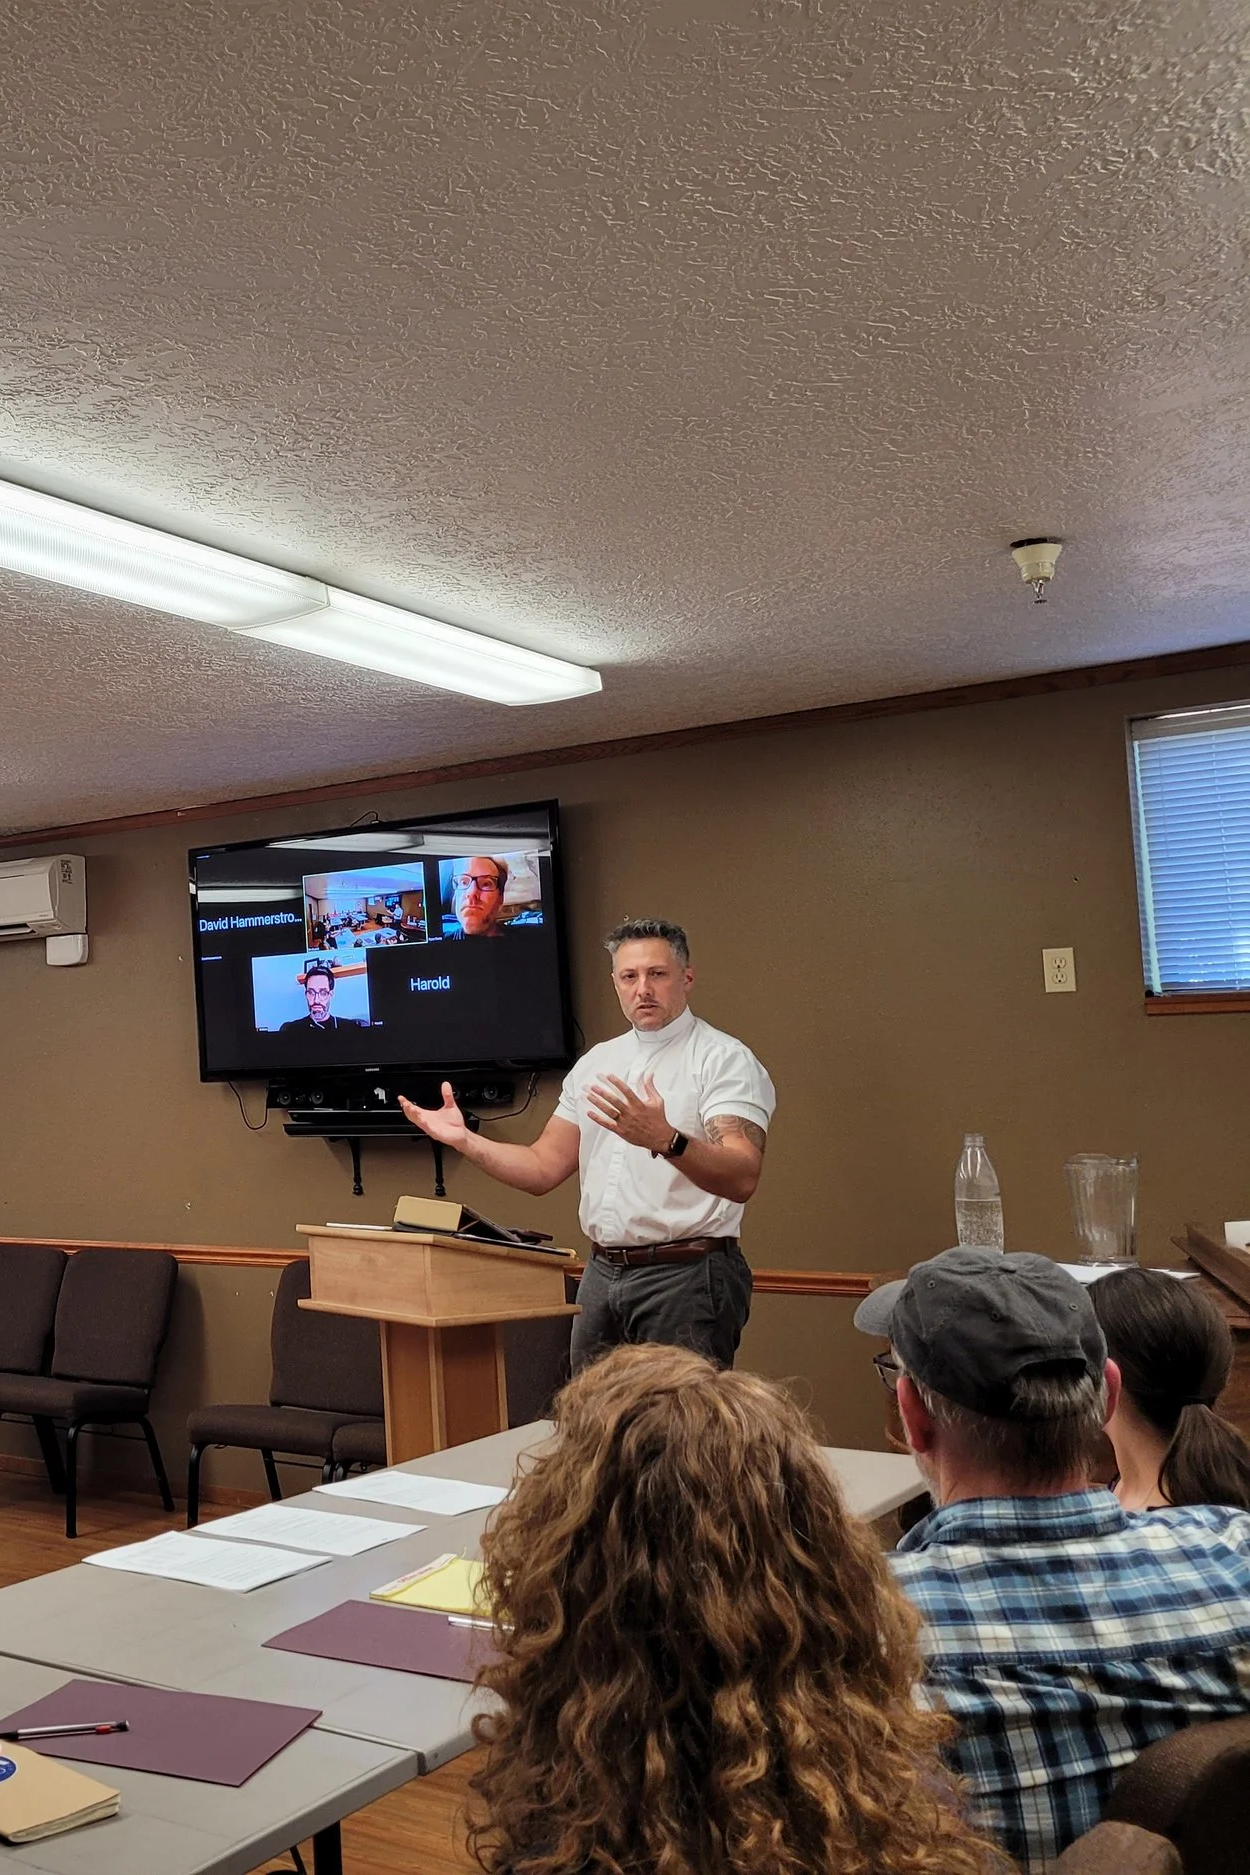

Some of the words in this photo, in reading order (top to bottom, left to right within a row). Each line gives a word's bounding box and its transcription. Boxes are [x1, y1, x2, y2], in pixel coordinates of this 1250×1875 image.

[199, 916, 229, 932] David
[230, 911, 303, 929] Hammerstro...
[410, 975, 450, 992] Harold
